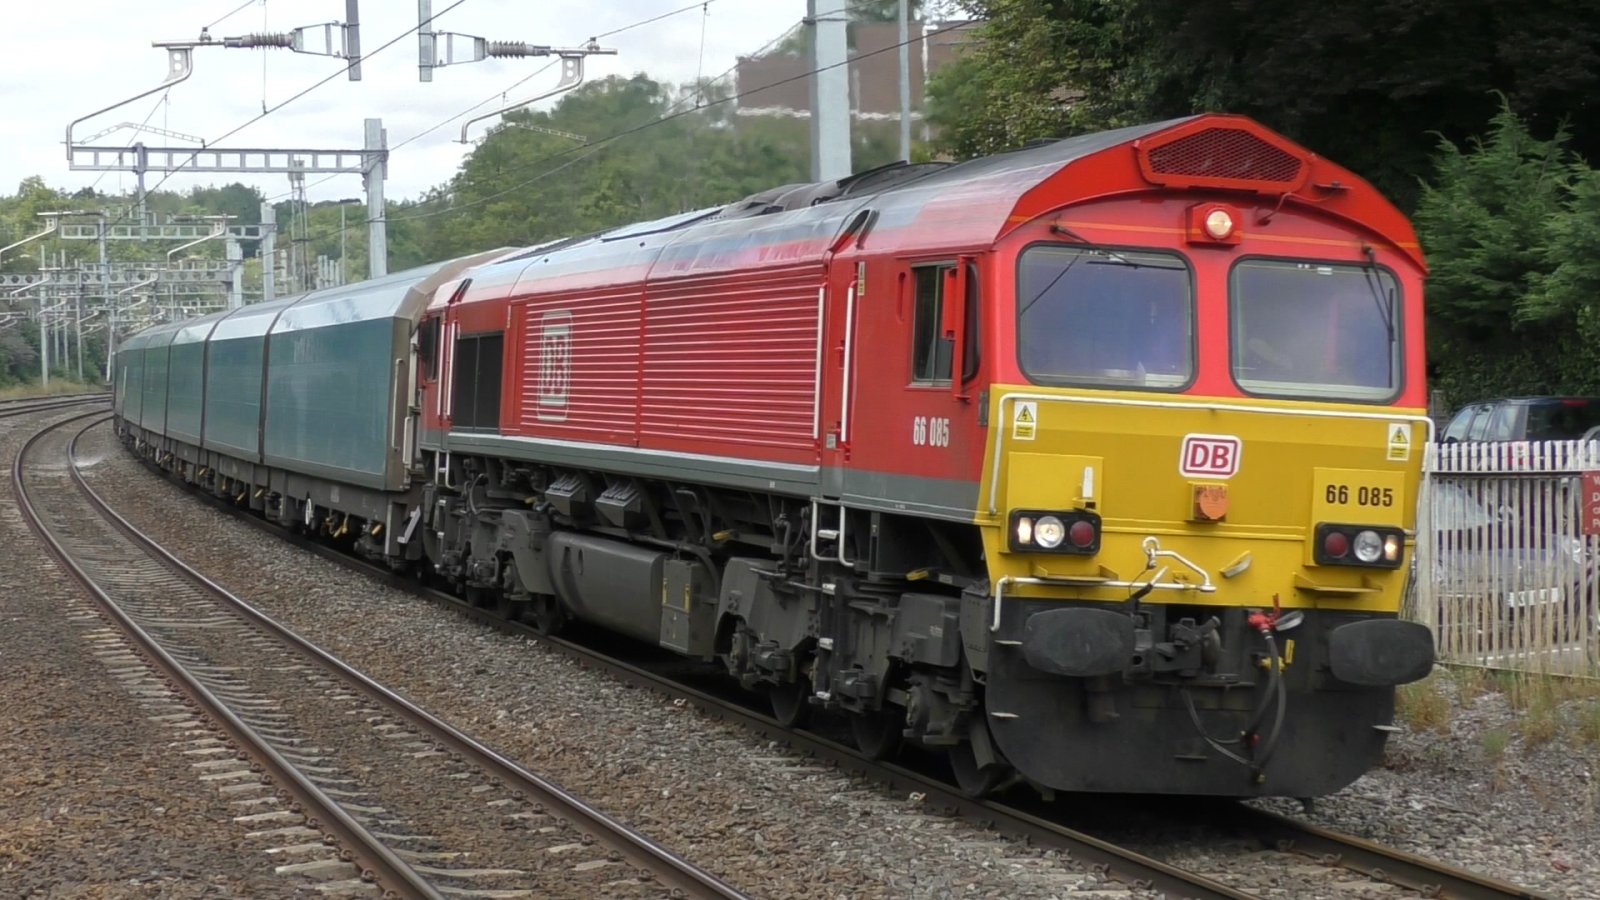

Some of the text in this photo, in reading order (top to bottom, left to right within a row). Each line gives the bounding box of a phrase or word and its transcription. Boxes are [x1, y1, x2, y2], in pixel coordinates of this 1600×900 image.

[913, 416, 950, 447] 66 085
[1189, 443, 1230, 469] DB
[1326, 484, 1393, 507] 66 085
